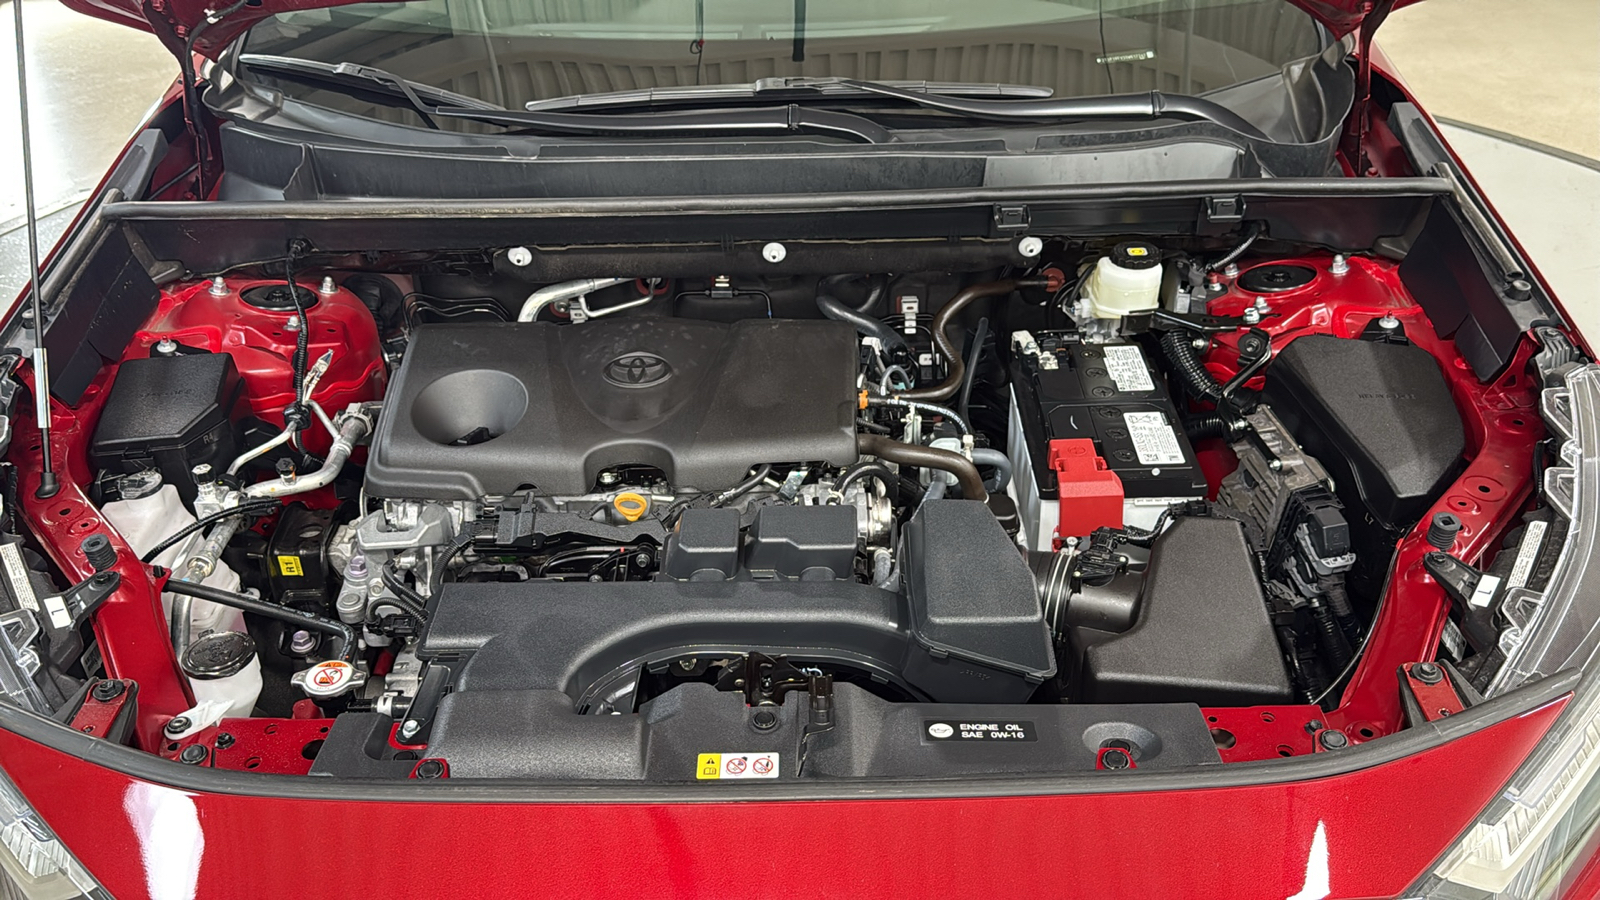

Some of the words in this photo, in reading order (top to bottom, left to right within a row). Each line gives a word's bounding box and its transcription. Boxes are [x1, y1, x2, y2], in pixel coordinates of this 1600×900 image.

[284, 561, 295, 573] R1
[959, 723, 999, 731] ENGINE
[990, 731, 1025, 739] 0W-16
